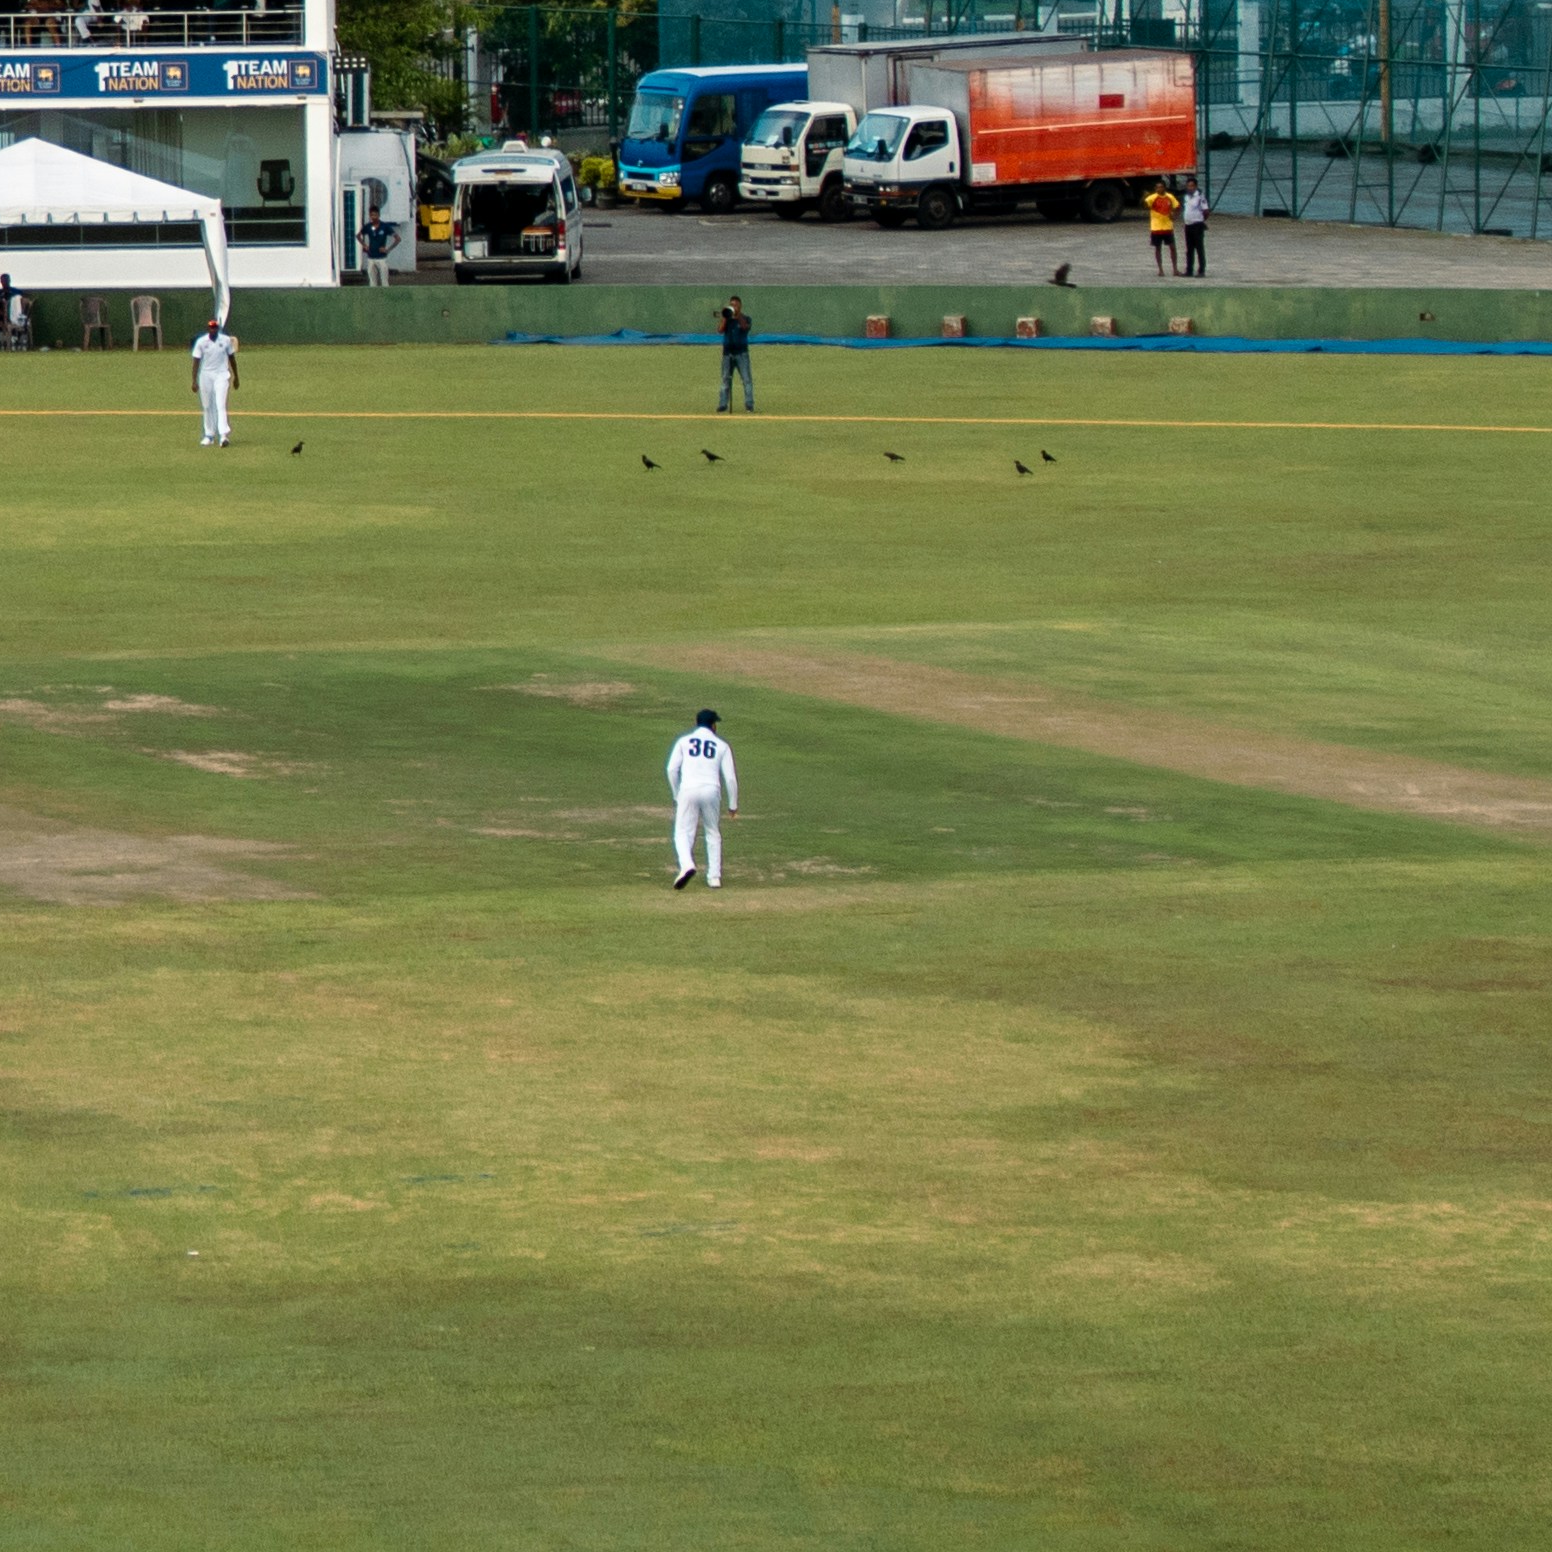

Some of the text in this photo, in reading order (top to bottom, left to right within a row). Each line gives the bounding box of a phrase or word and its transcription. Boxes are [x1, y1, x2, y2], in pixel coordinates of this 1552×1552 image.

[108, 76, 159, 91] NATION
[236, 75, 288, 89] NATION
[688, 737, 717, 759] 36
